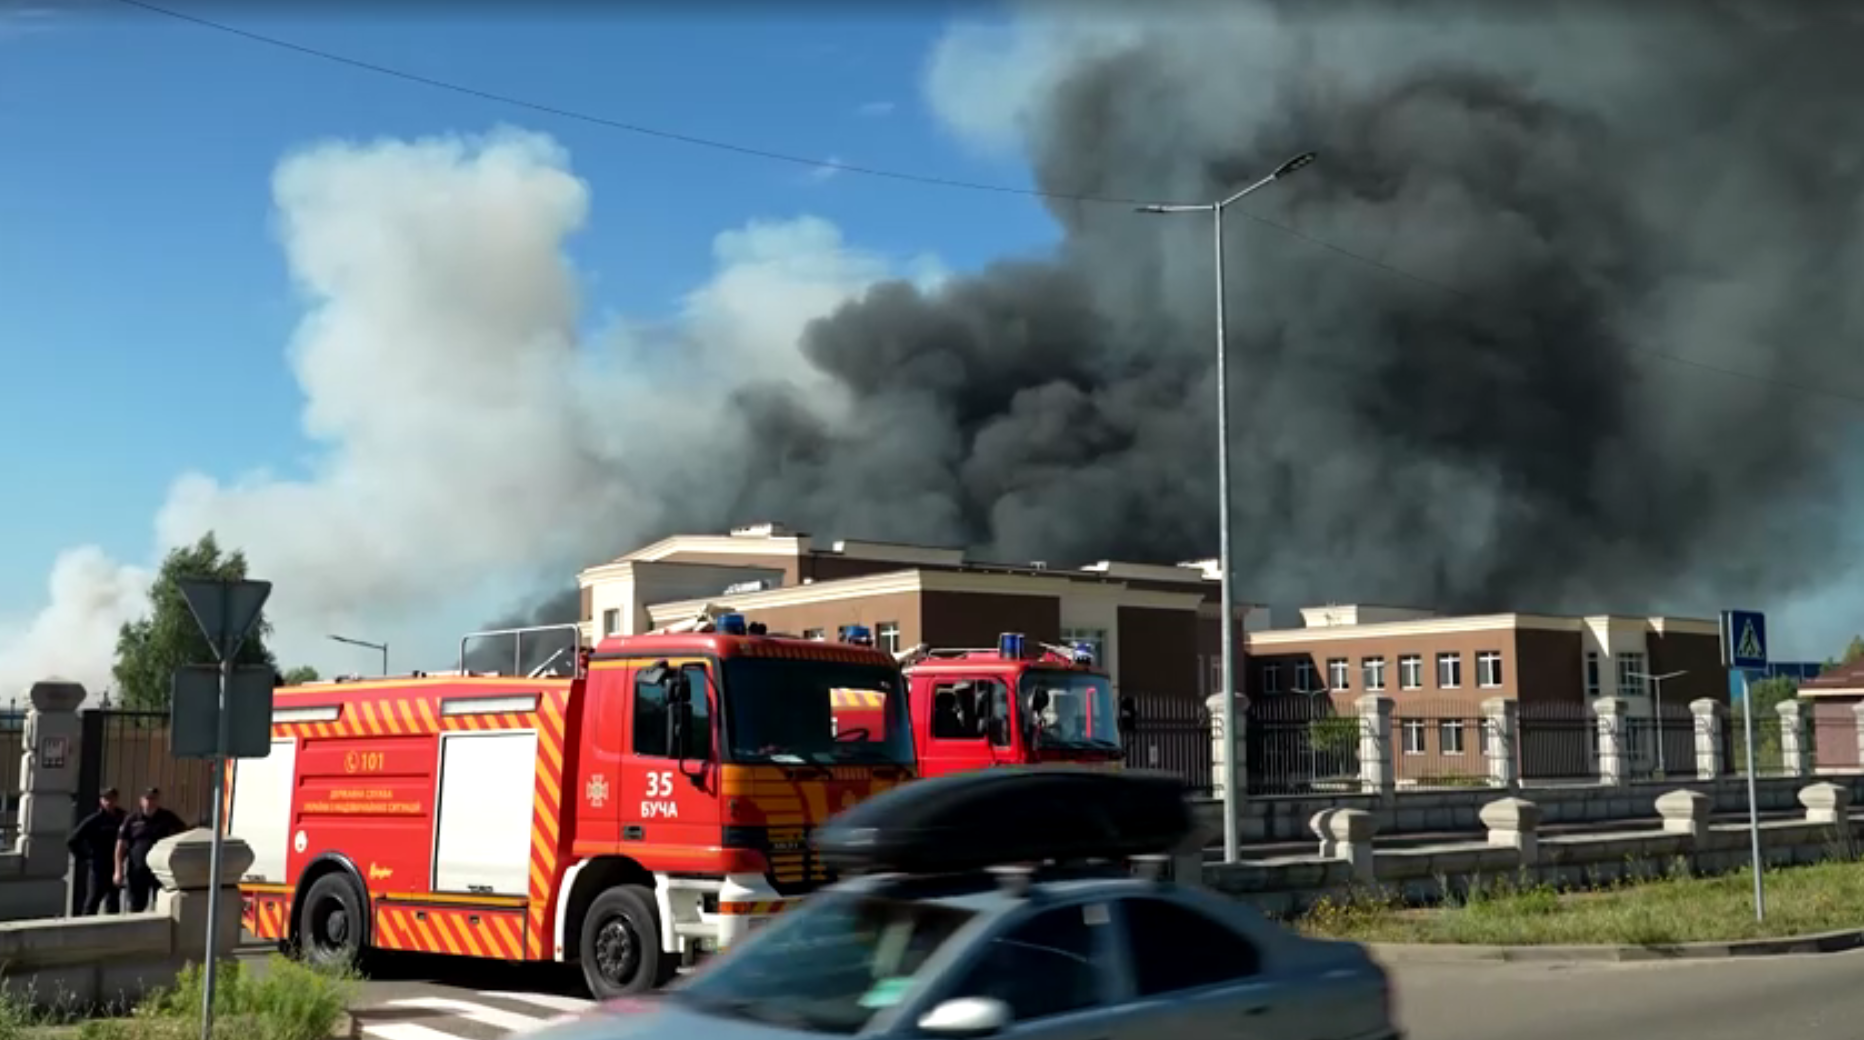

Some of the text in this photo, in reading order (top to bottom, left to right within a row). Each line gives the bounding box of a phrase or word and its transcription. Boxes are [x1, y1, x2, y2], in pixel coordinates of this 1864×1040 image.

[361, 752, 384, 771] 101
[646, 772, 673, 797] 35
[641, 801, 678, 818] БУЧА
